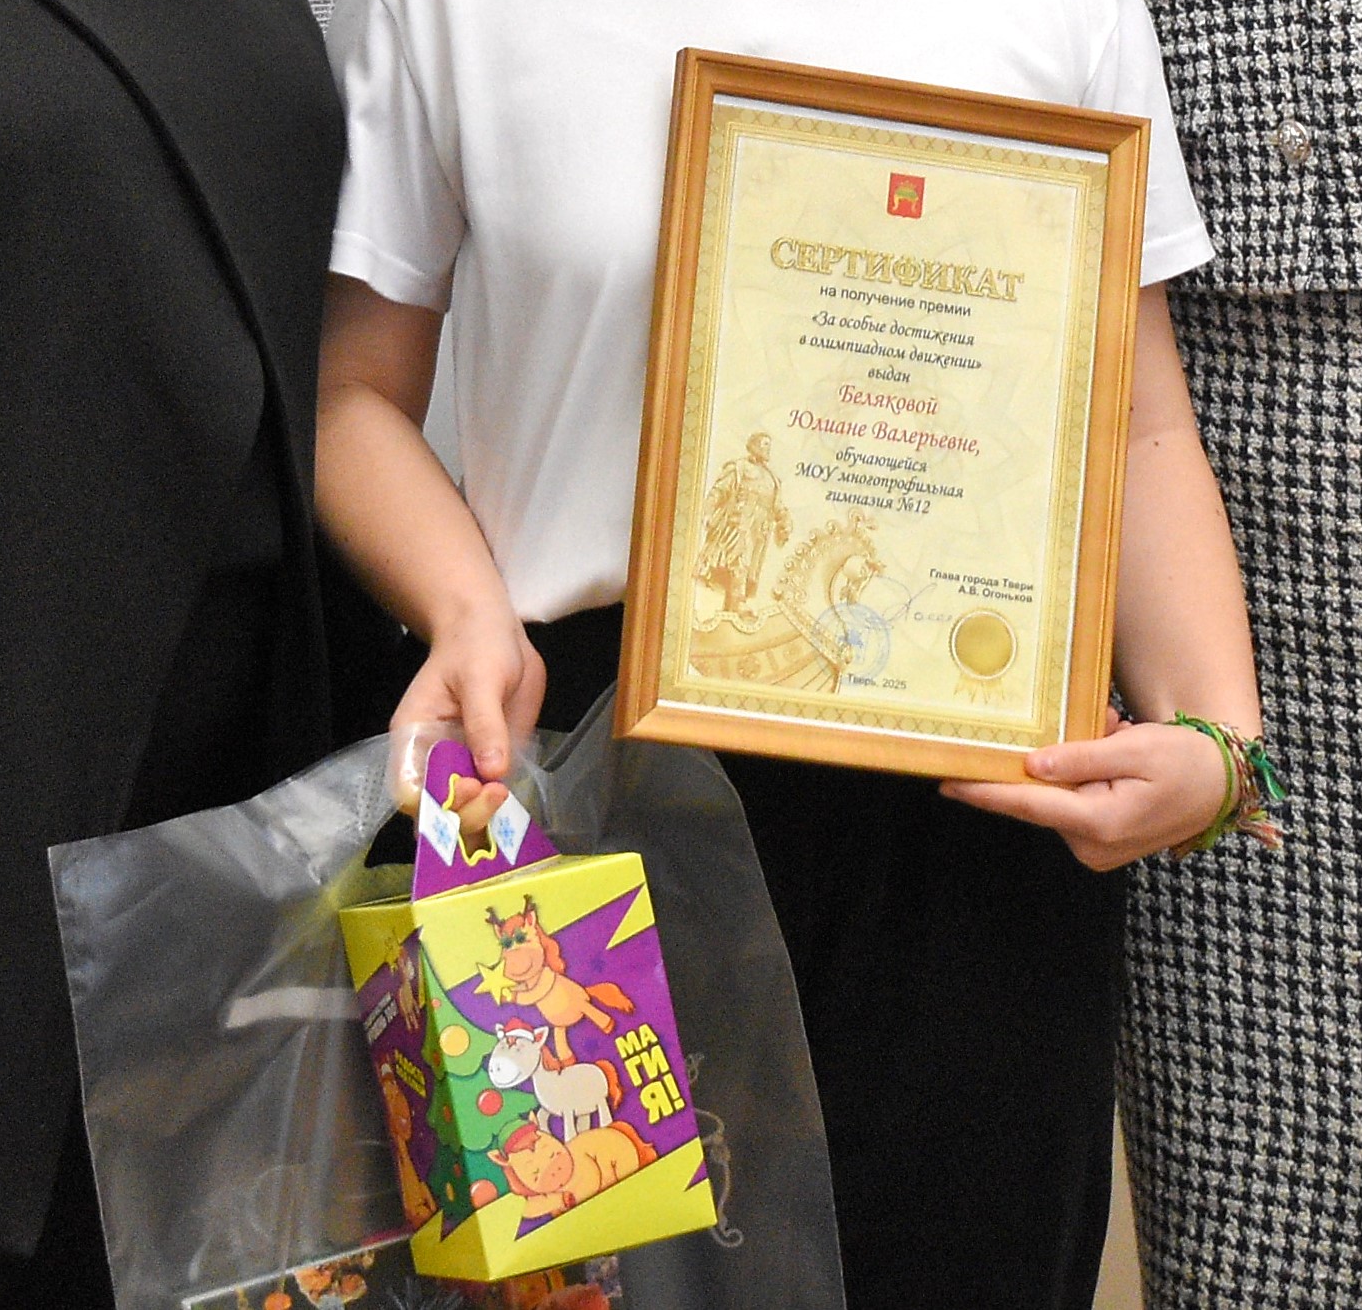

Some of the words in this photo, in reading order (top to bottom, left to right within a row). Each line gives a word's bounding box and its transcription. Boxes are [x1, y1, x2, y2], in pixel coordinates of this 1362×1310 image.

[770, 236, 1026, 303] СЕРТИФИКАТ
[819, 285, 837, 298] на
[840, 288, 916, 312] получение
[919, 299, 972, 318] премии
[812, 310, 836, 327] «За
[839, 314, 887, 333] особые
[889, 319, 976, 347] достижения
[799, 335, 807, 345] в
[809, 336, 906, 361] олимпиадном
[909, 347, 983, 371] движении»
[867, 364, 911, 383] выдан
[839, 384, 939, 416] Беляковой
[787, 409, 868, 438] Юлиане
[871, 421, 981, 457] Валерьевне,
[836, 447, 928, 473] обучающейся
[795, 462, 838, 483] МОУ
[838, 471, 964, 499] многопрофильная
[825, 490, 894, 510] гимназия
[896, 496, 931, 515] №12
[929, 568, 960, 583] Глава
[962, 574, 1000, 588] города
[1002, 578, 1034, 592] Твери
[957, 585, 980, 597] А.В.
[982, 588, 1034, 604] Огоньков
[882, 679, 908, 690] 2025
[615, 1023, 659, 1059] МА
[624, 1045, 670, 1087] ГИ
[640, 1073, 686, 1125] Я!
